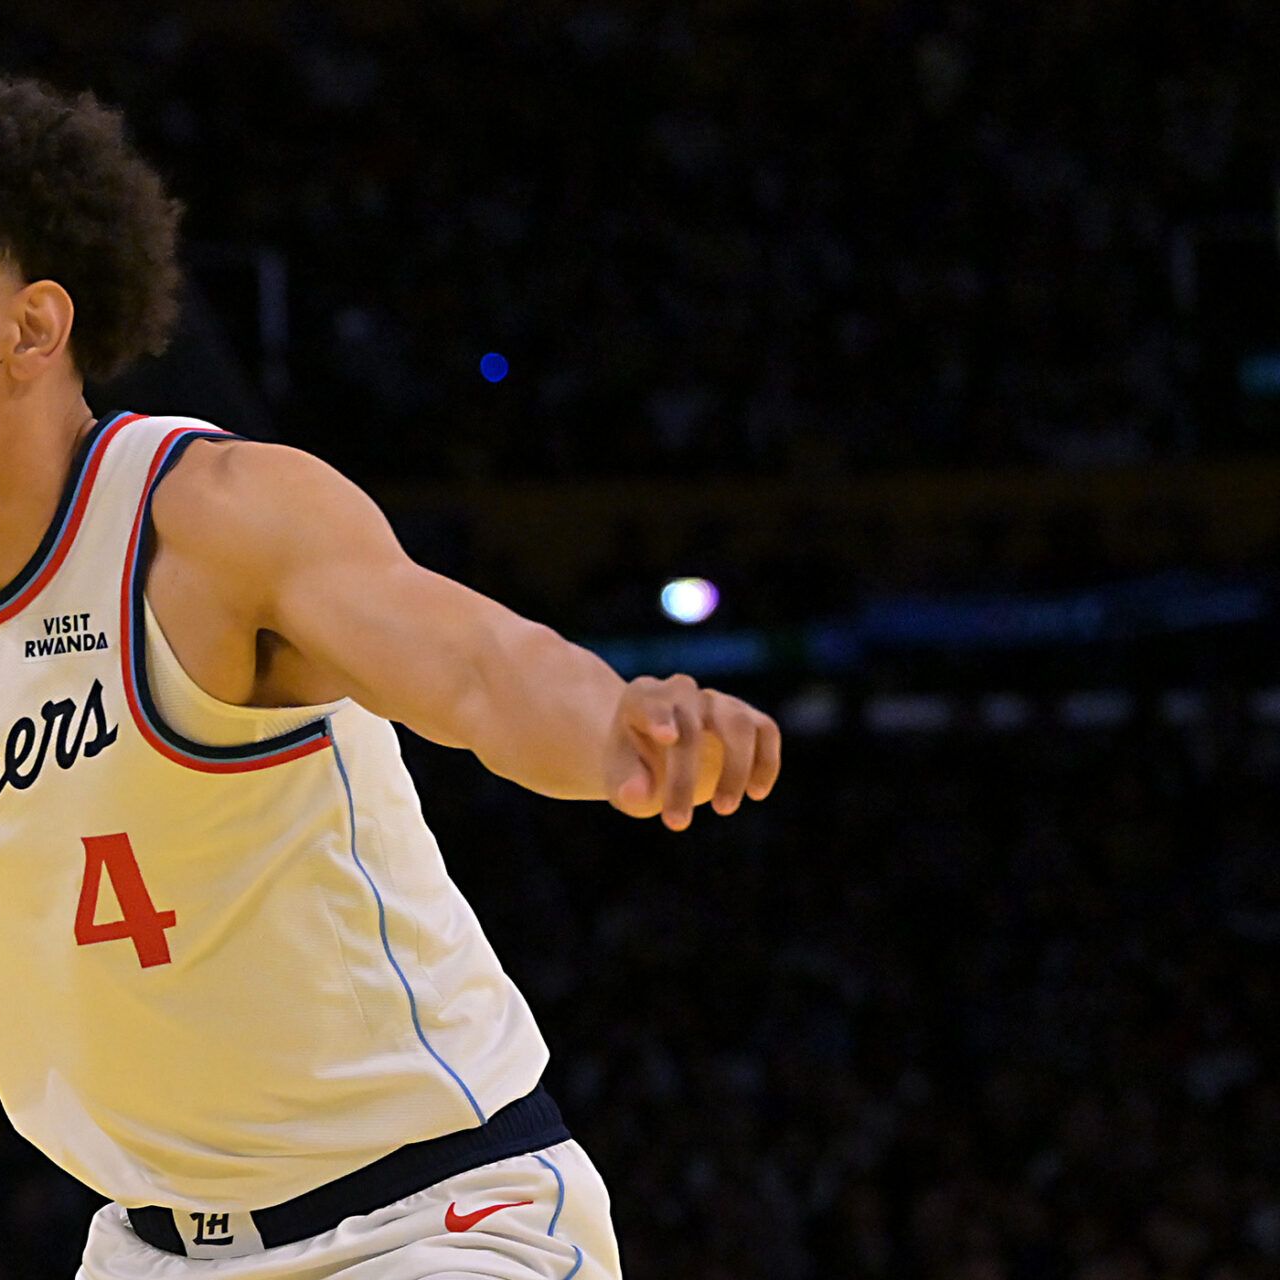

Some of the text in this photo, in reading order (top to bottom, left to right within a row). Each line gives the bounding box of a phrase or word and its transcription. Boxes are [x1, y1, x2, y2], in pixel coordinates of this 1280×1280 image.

[43, 613, 90, 635] VISIT
[25, 632, 108, 658] RWANDA
[74, 832, 176, 968] 4
